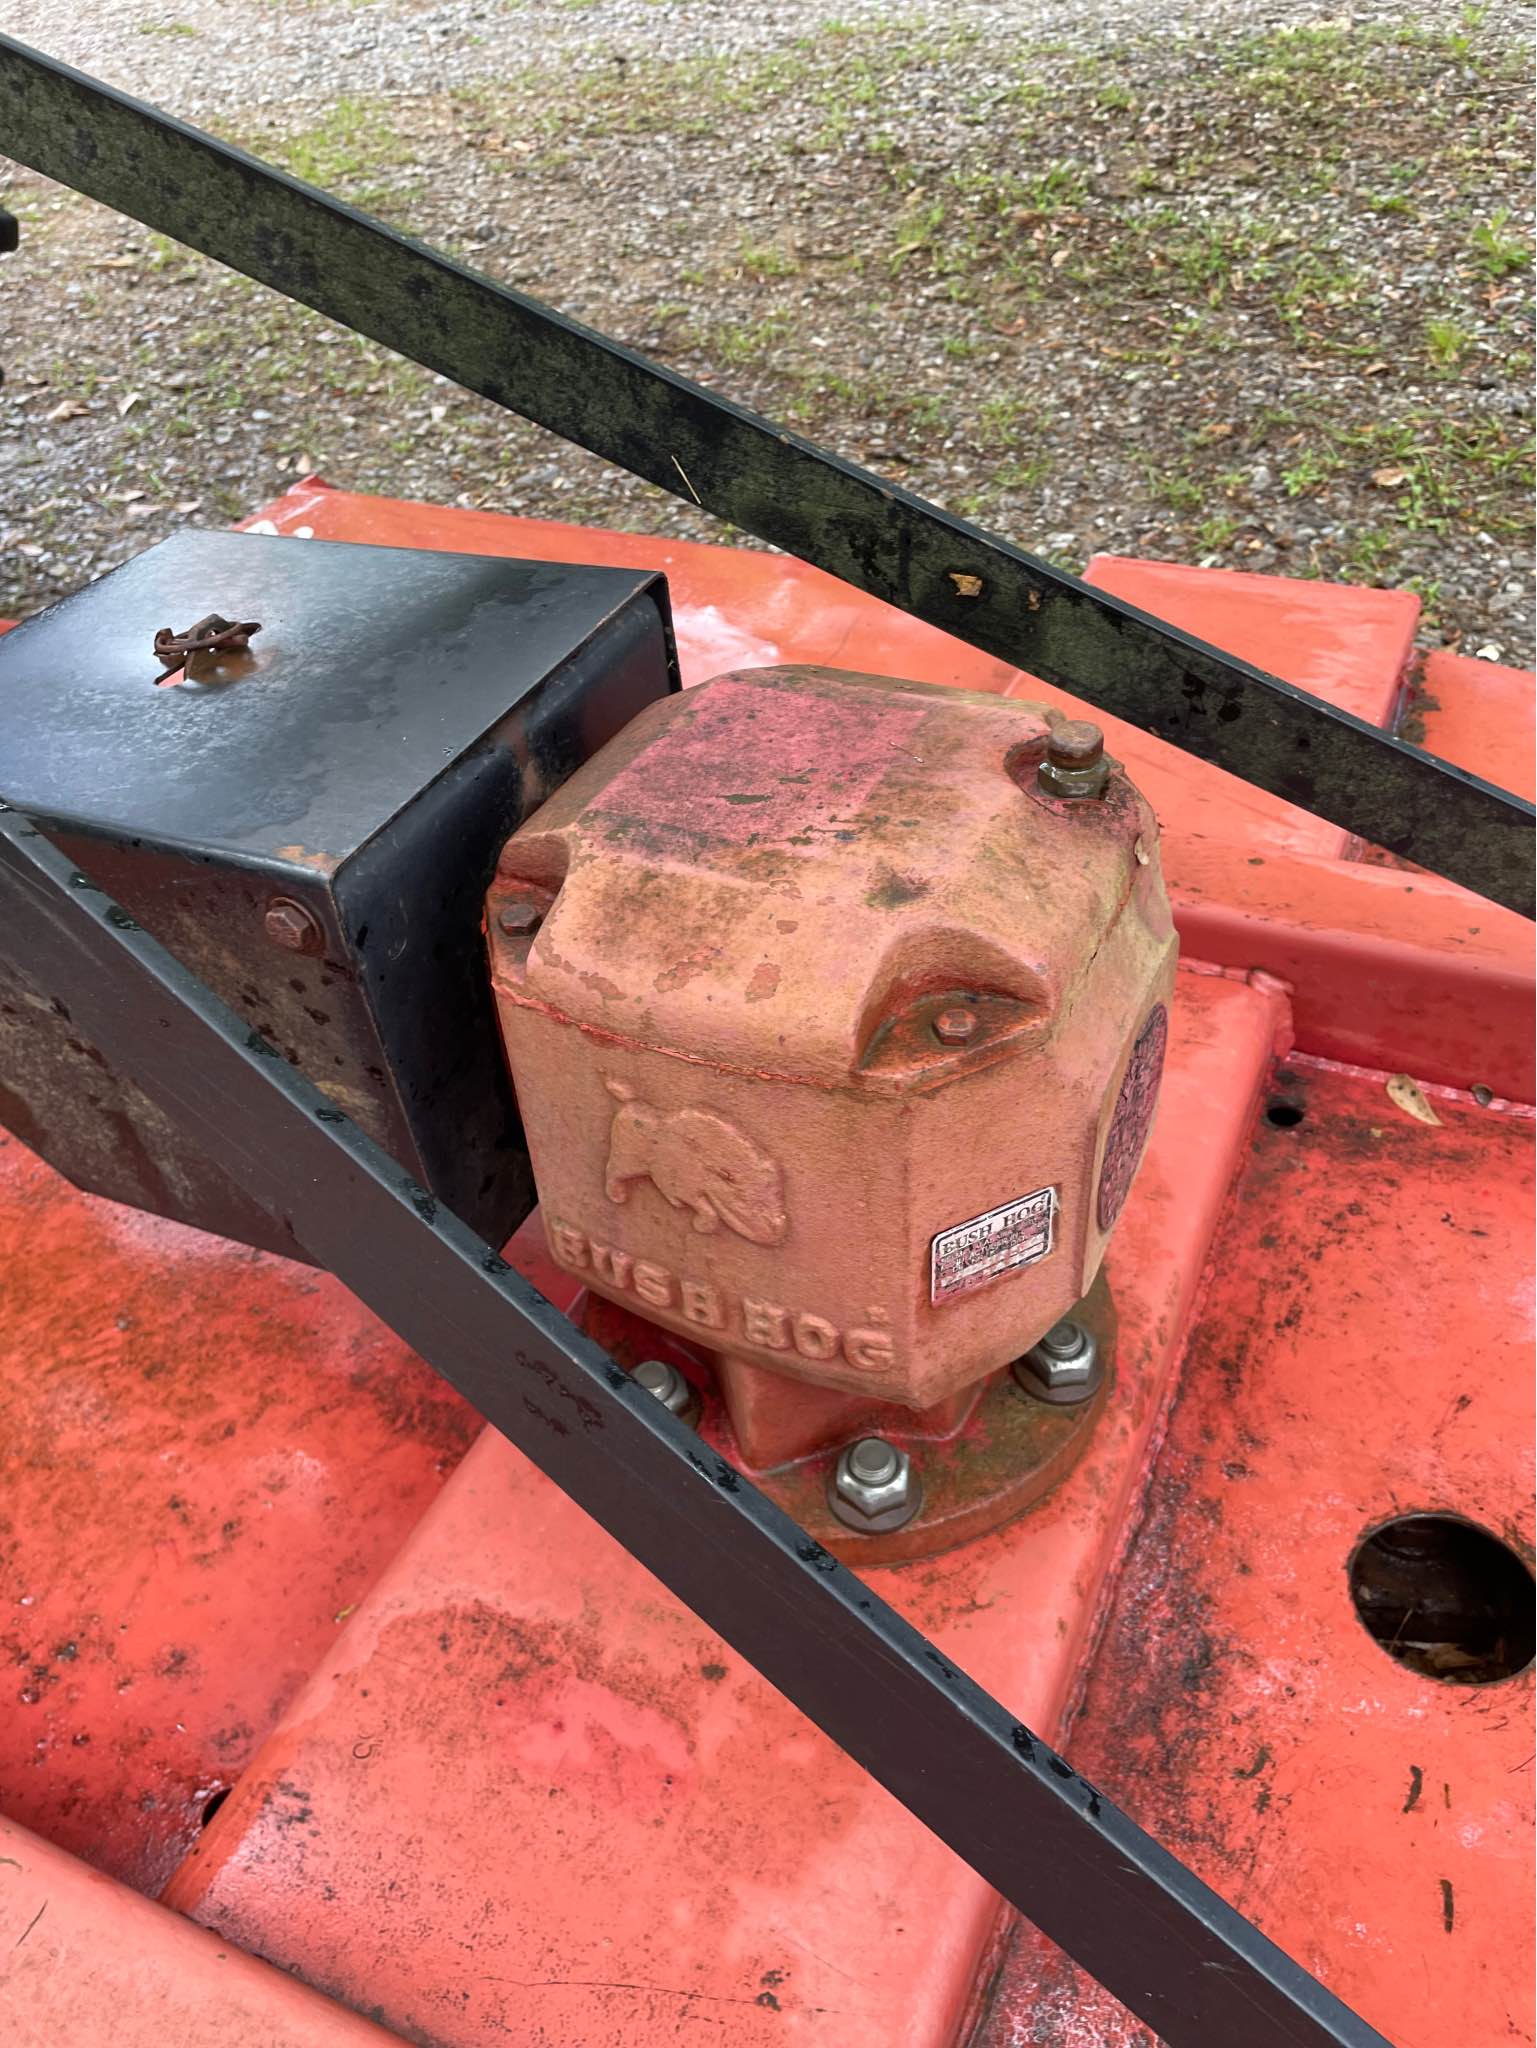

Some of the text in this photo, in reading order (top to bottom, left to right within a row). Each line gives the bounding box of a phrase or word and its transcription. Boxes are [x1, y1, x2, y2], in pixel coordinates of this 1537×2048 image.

[942, 1200, 1046, 1255] BUSH HOG
[552, 1220, 896, 1371] BUSH HOG
